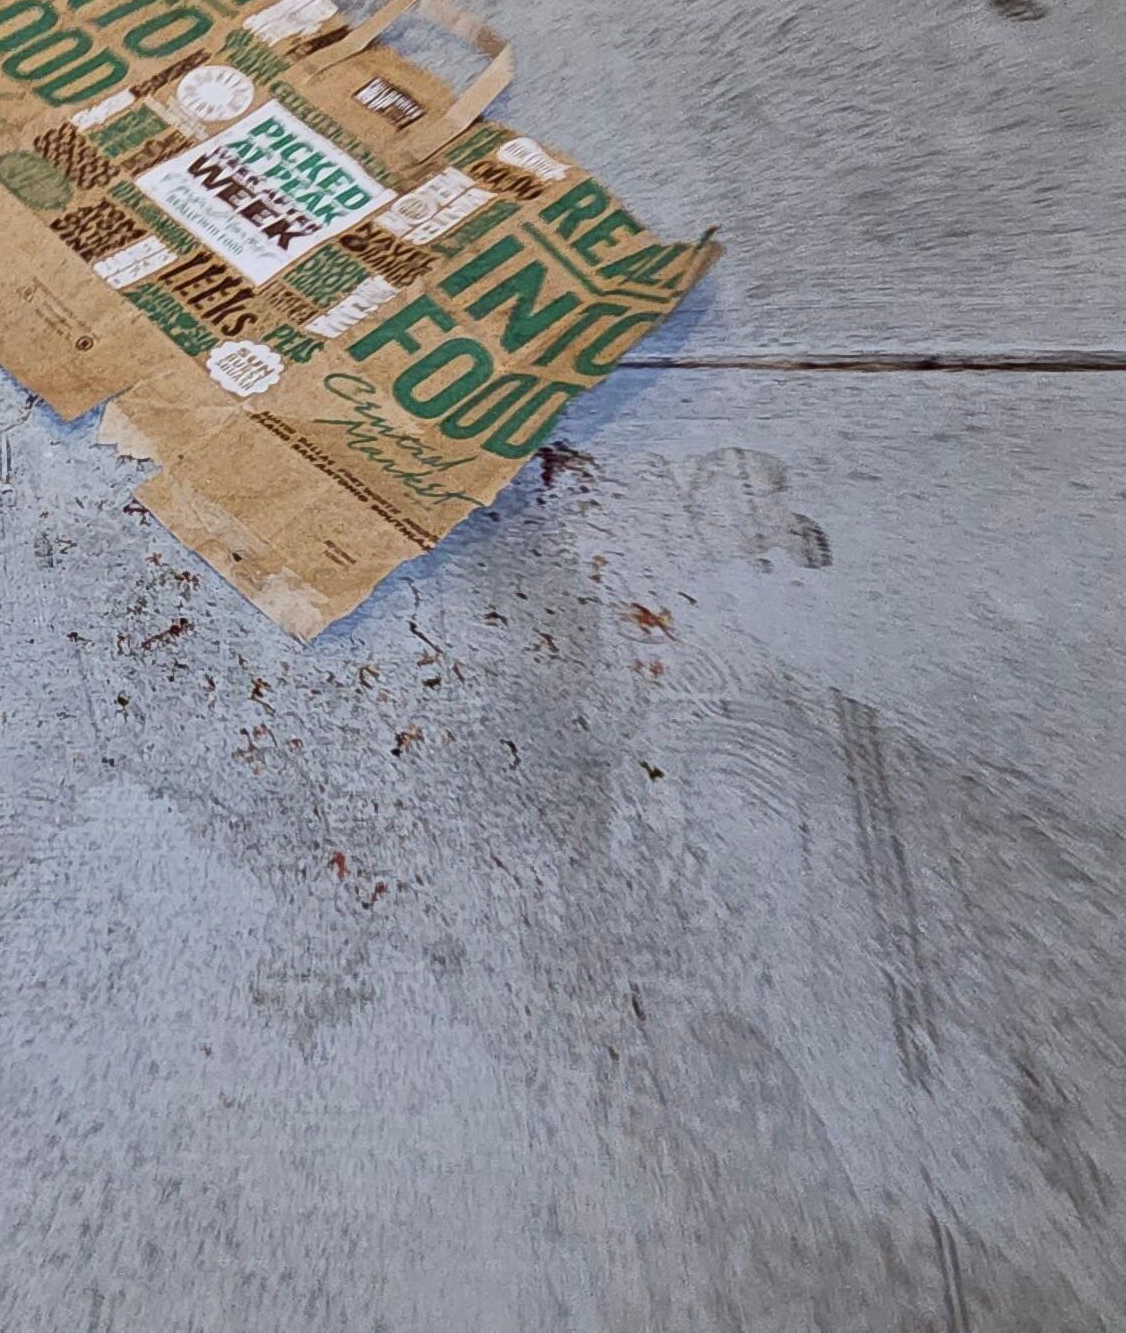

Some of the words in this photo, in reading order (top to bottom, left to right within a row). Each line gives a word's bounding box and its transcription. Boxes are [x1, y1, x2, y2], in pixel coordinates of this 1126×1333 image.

[187, 153, 318, 251] WEEK
[226, 137, 266, 165] AT
[265, 163, 345, 227] PEAK
[248, 116, 372, 211] PICKED
[157, 251, 258, 337] LEEKS
[324, 373, 478, 471] Central
[346, 294, 587, 459] FOOD
[313, 418, 486, 505] Market
